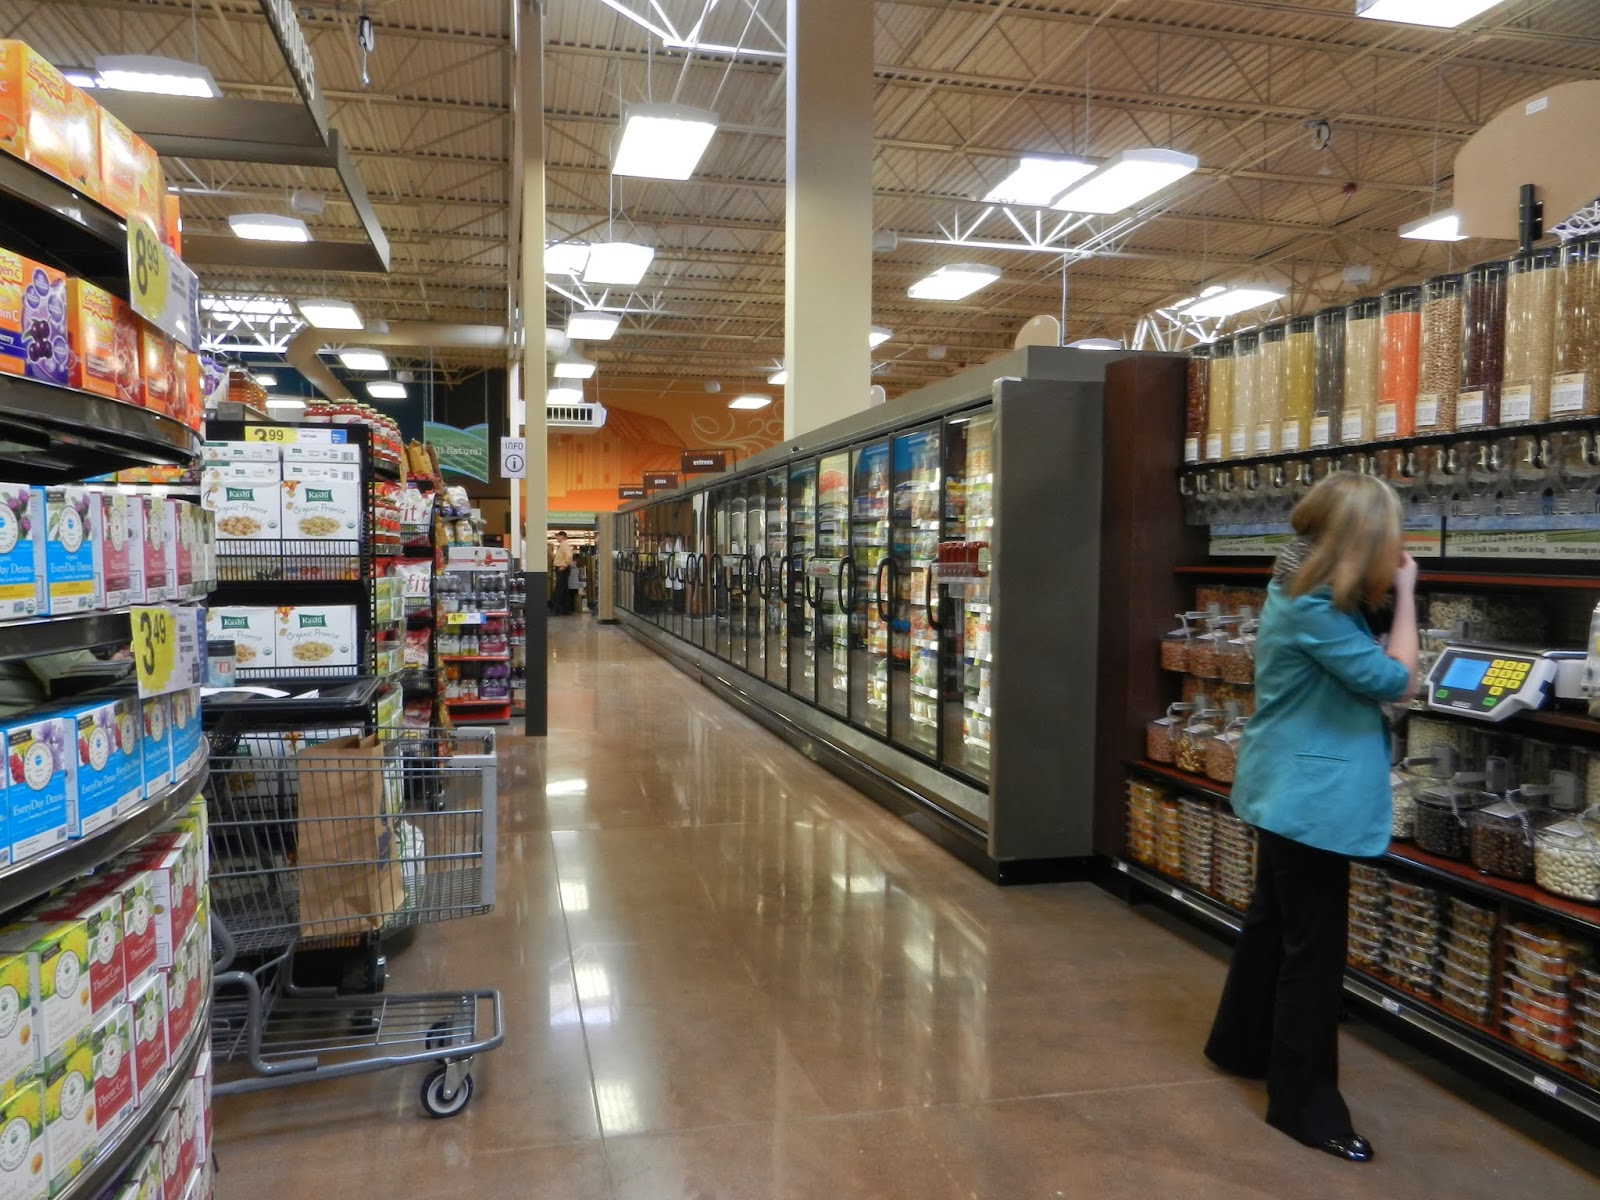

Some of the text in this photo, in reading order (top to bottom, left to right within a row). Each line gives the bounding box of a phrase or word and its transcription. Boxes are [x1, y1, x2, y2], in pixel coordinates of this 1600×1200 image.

[446, 446, 483, 456] Natural
[505, 442, 524, 451] INFO
[229, 490, 251, 498] Kashi
[308, 491, 330, 499] Kashi
[293, 503, 347, 516] Organic Promise
[407, 573, 429, 593] fit
[224, 618, 246, 626] Kashi
[302, 616, 323, 624] Kashi
[287, 628, 340, 641] Organic Promise
